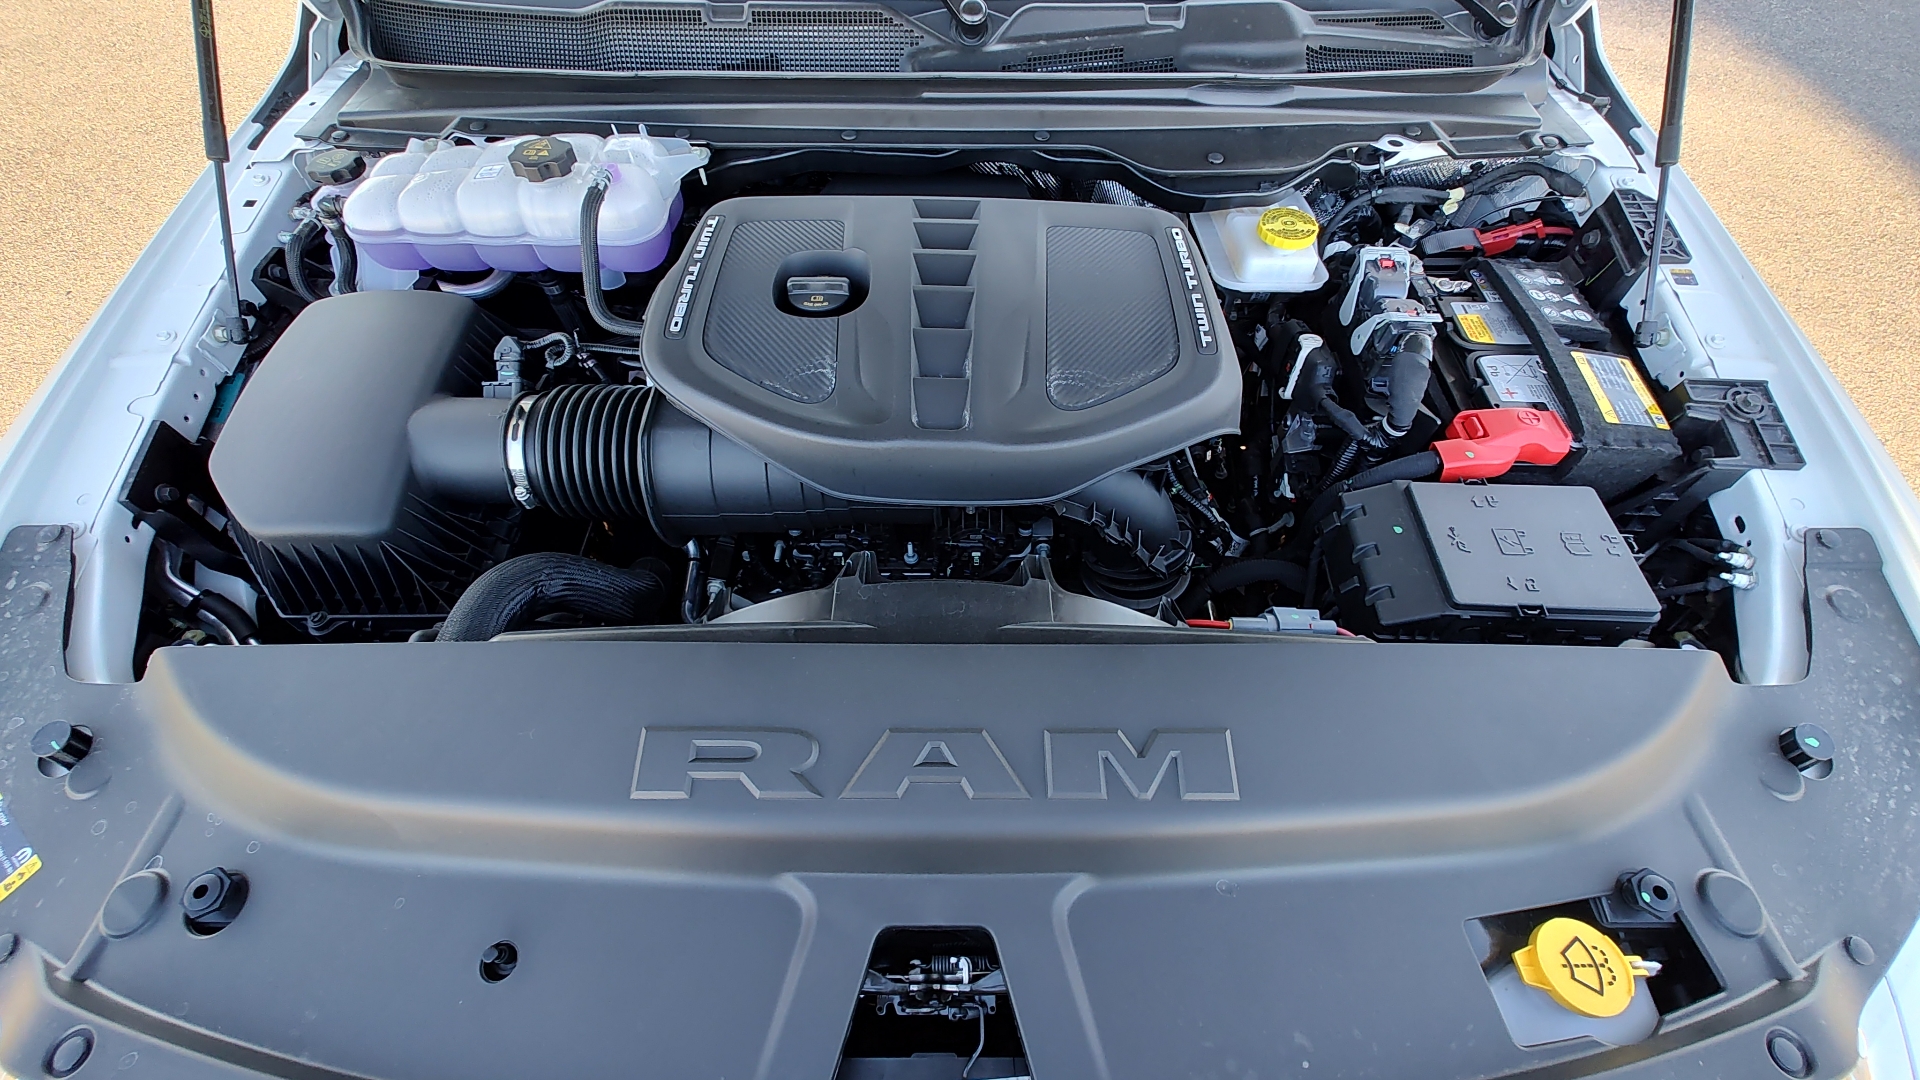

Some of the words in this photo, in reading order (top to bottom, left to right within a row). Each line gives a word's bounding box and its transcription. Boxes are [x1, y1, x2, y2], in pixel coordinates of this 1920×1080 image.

[693, 216, 719, 259] TWIN
[1171, 228, 1198, 290] TURBO
[669, 262, 701, 332] TURBO
[1191, 293, 1212, 347] TWIN
[1486, 365, 1501, 377] Pb
[630, 727, 1241, 800] RAM
